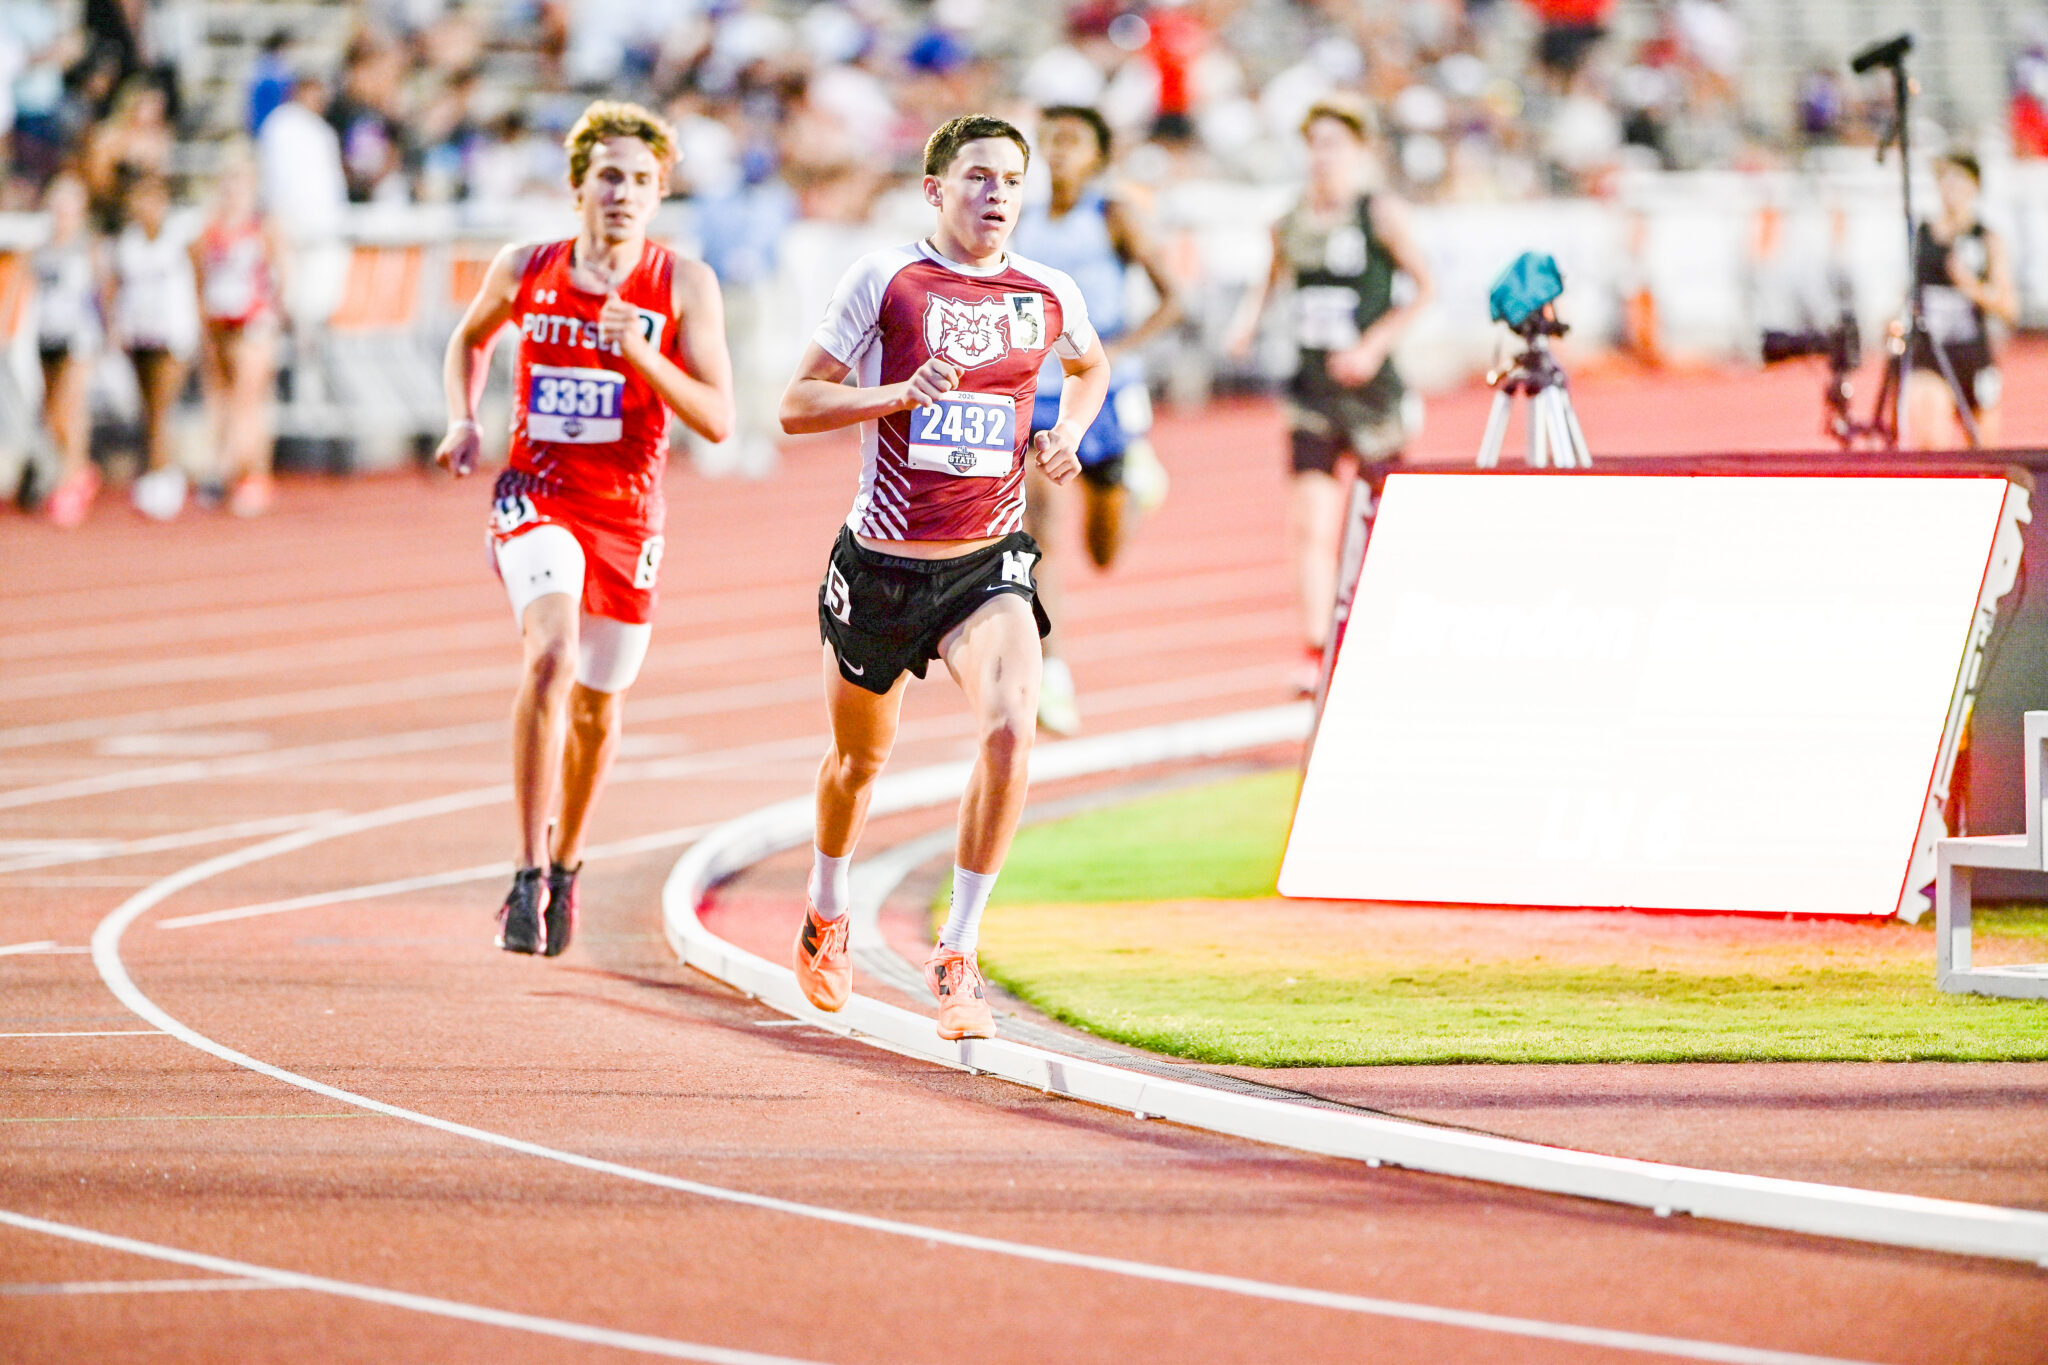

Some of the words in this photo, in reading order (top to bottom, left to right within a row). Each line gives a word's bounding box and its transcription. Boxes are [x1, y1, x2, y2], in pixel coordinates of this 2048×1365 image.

[1012, 296, 1038, 346] 5
[537, 378, 615, 417] 3331
[920, 403, 1006, 446] 2432
[948, 455, 977, 465] STATE
[829, 571, 844, 616] 5
